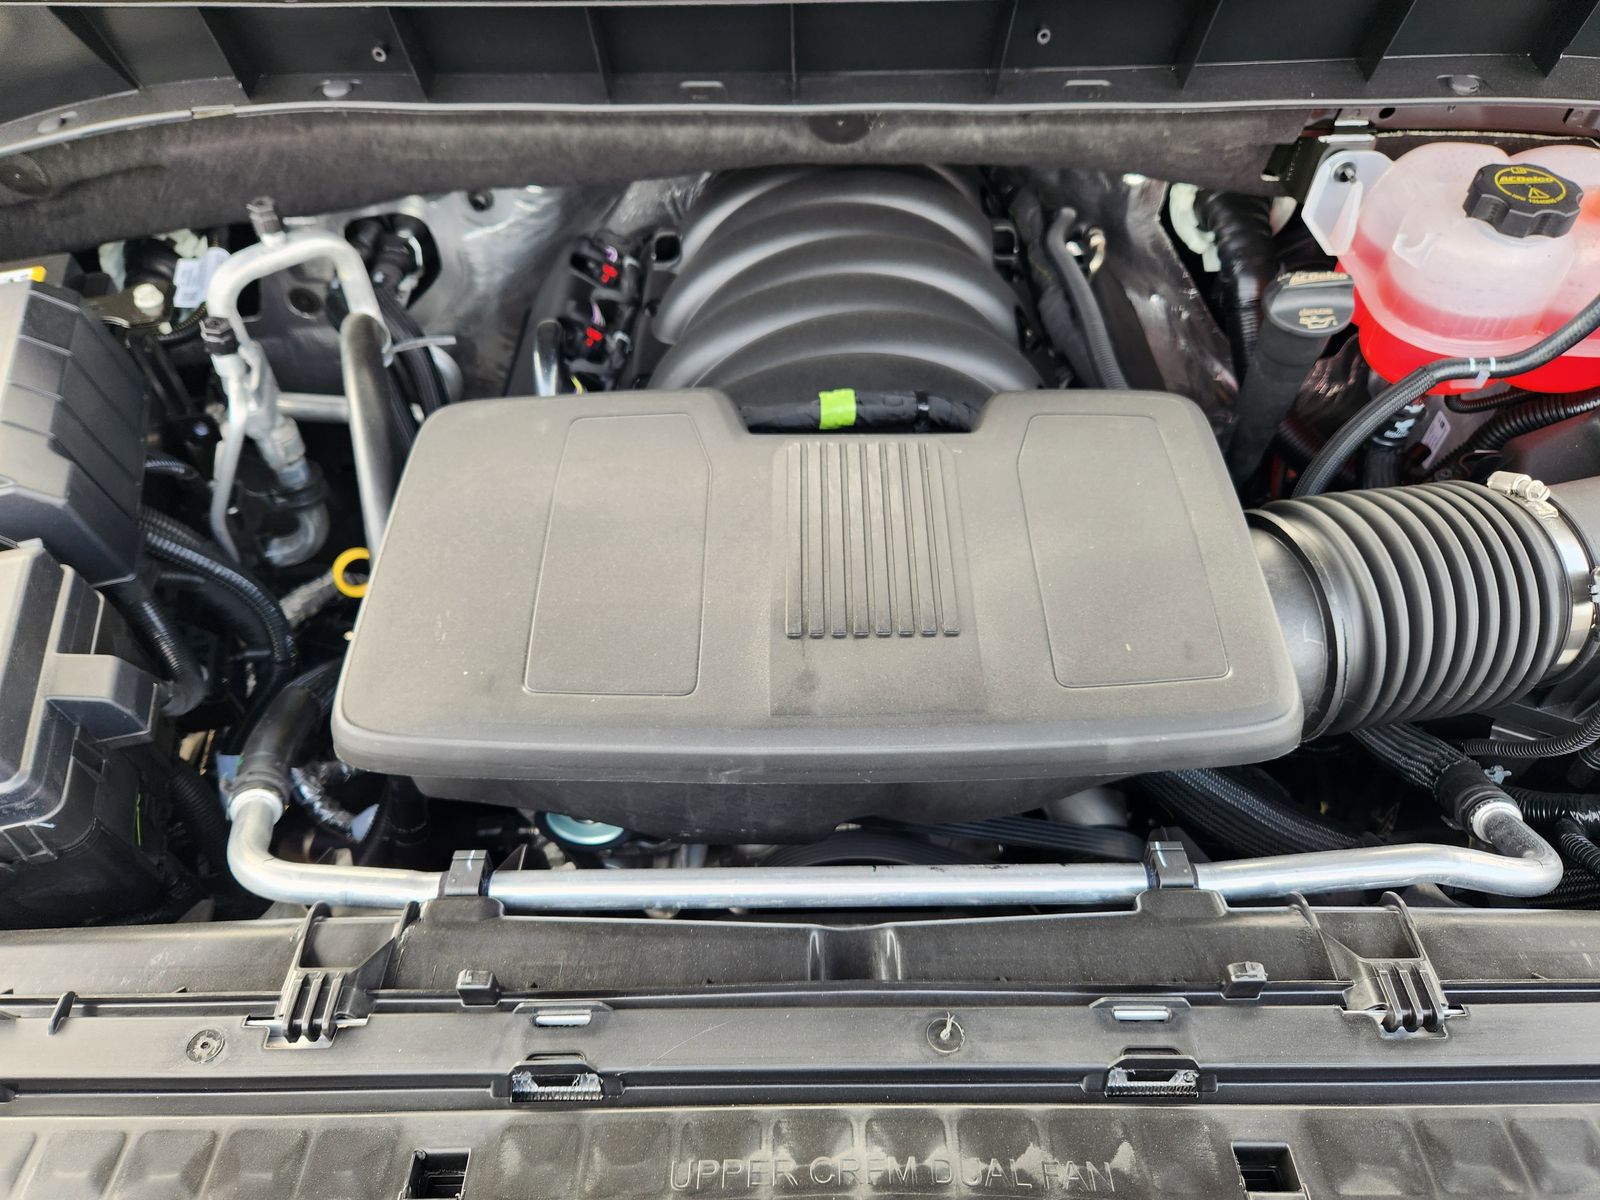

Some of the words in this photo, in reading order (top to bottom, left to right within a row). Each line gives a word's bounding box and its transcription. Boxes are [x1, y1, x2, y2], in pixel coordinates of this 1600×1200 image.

[670, 1158, 798, 1191] UPPER
[931, 1157, 1032, 1188] DUAL
[1042, 1160, 1115, 1192] FAN
